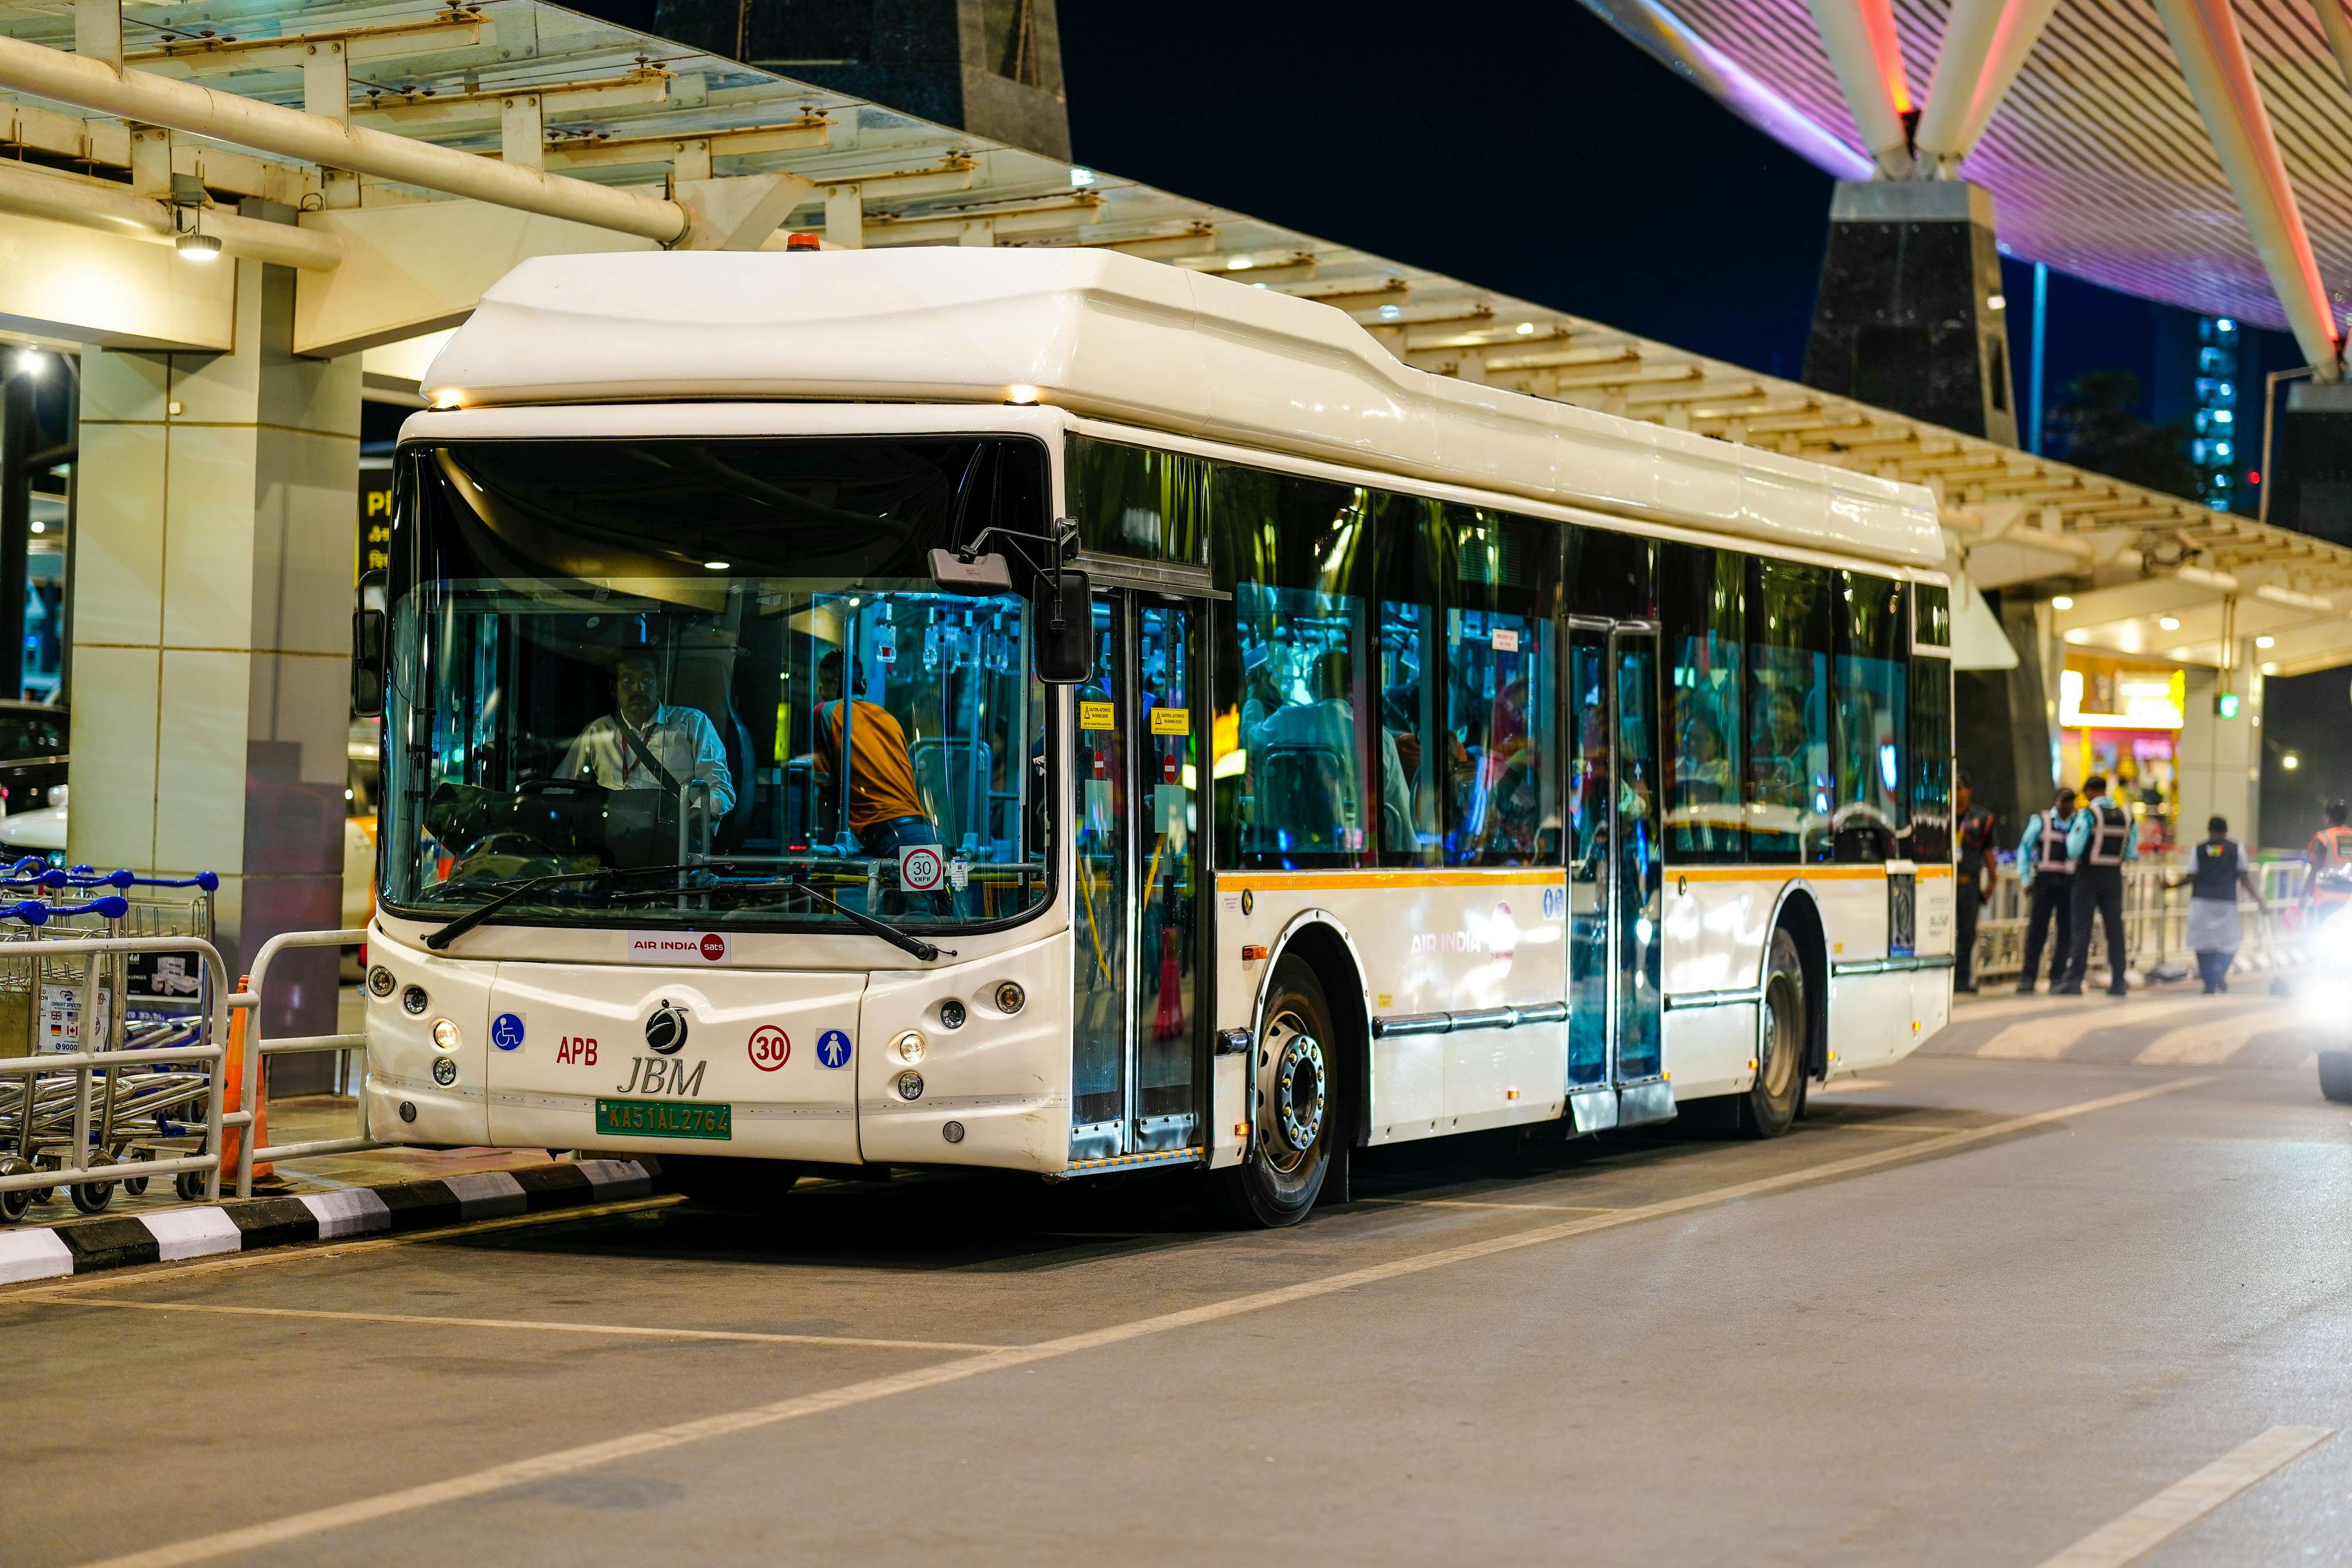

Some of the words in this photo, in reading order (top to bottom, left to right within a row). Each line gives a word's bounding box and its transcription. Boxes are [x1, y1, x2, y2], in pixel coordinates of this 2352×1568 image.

[913, 861, 931, 876] 30
[634, 941, 657, 949] AIR
[661, 942, 698, 950] INDIA
[1411, 933, 1437, 957] AIR
[1440, 931, 1481, 954] INDIA
[556, 1036, 598, 1066] APB
[756, 1036, 785, 1061] 30
[616, 1056, 707, 1096] JBM
[609, 1106, 728, 1133] KA51AL2764
